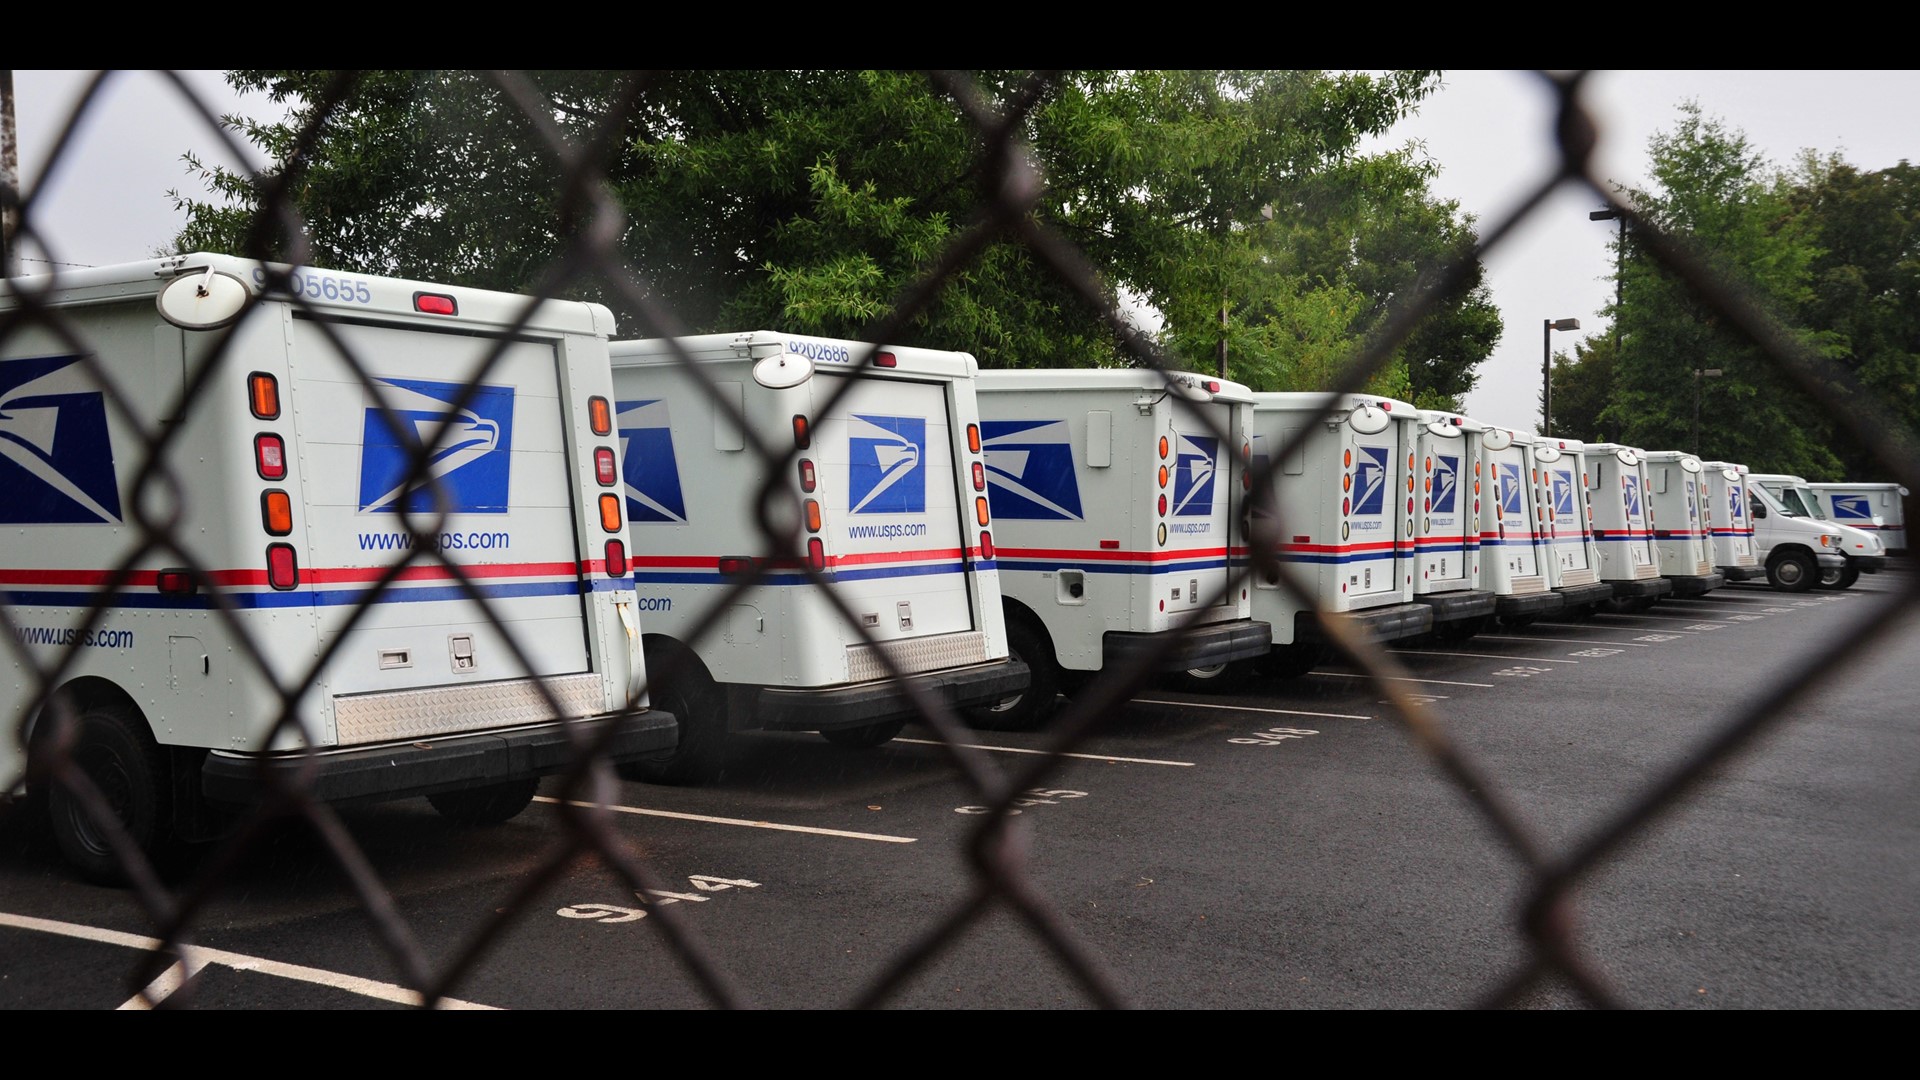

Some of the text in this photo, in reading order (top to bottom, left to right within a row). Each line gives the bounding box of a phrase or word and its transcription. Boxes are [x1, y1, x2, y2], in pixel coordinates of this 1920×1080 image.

[253, 267, 371, 304] 905655
[789, 340, 849, 363] 9202686
[358, 532, 510, 555] www.sps.com
[848, 523, 926, 541] www.usps.com
[1227, 727, 1320, 746] 948
[556, 874, 763, 923] 944
